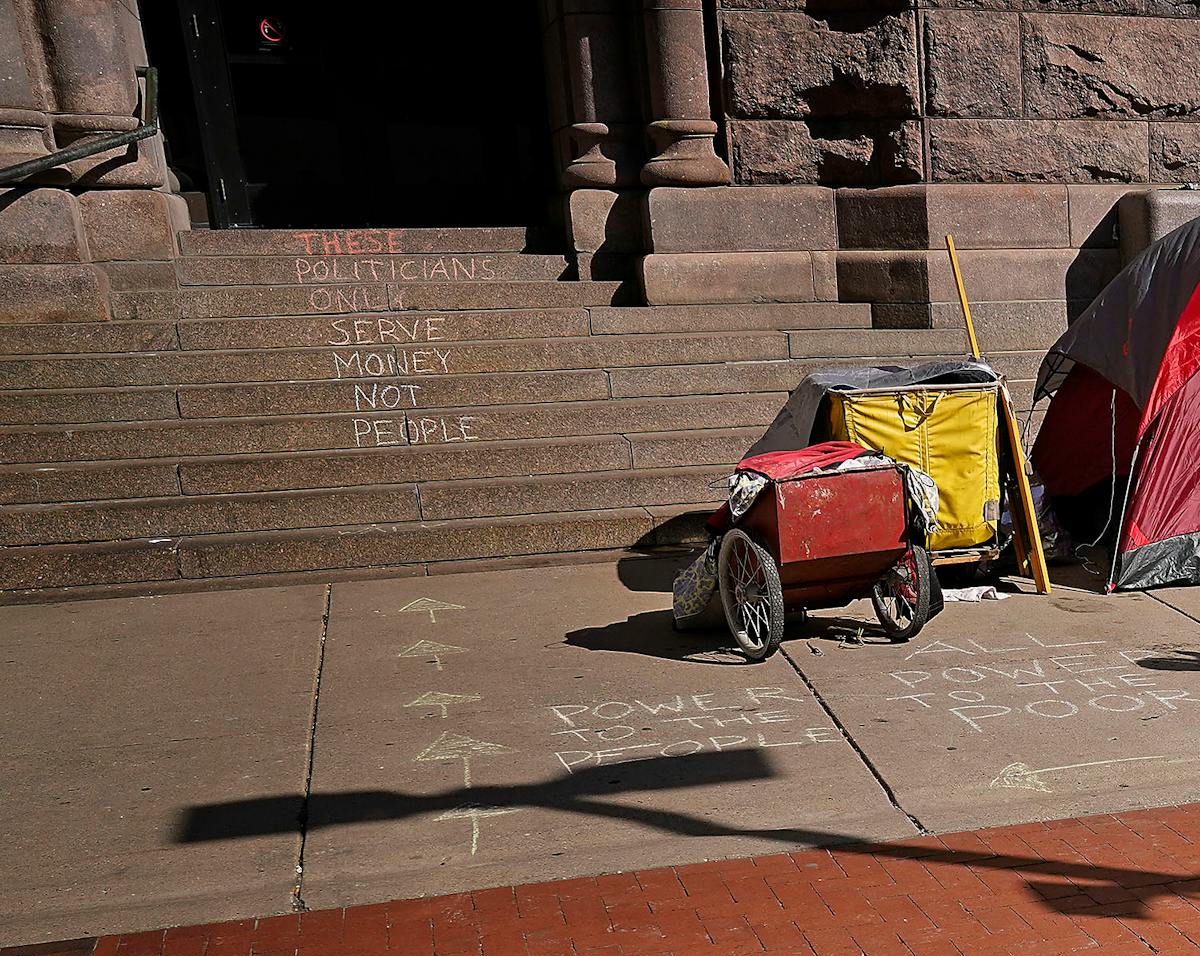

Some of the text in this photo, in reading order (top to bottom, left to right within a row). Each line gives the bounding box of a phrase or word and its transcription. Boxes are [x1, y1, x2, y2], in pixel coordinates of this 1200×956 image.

[293, 230, 404, 256] THESE
[295, 255, 496, 284] POLITICIANS
[309, 284, 407, 312] ONLY
[327, 316, 446, 346] SERVE
[332, 347, 452, 380] MONEY
[353, 383, 422, 411] NOT
[351, 415, 480, 447] PEOPLE
[904, 632, 1108, 661] ALL
[888, 650, 1160, 689] POWER
[885, 672, 1158, 709] TO THE
[550, 687, 805, 728] POWER
[550, 709, 802, 742] TO THE
[553, 727, 845, 776] PEOPLE
